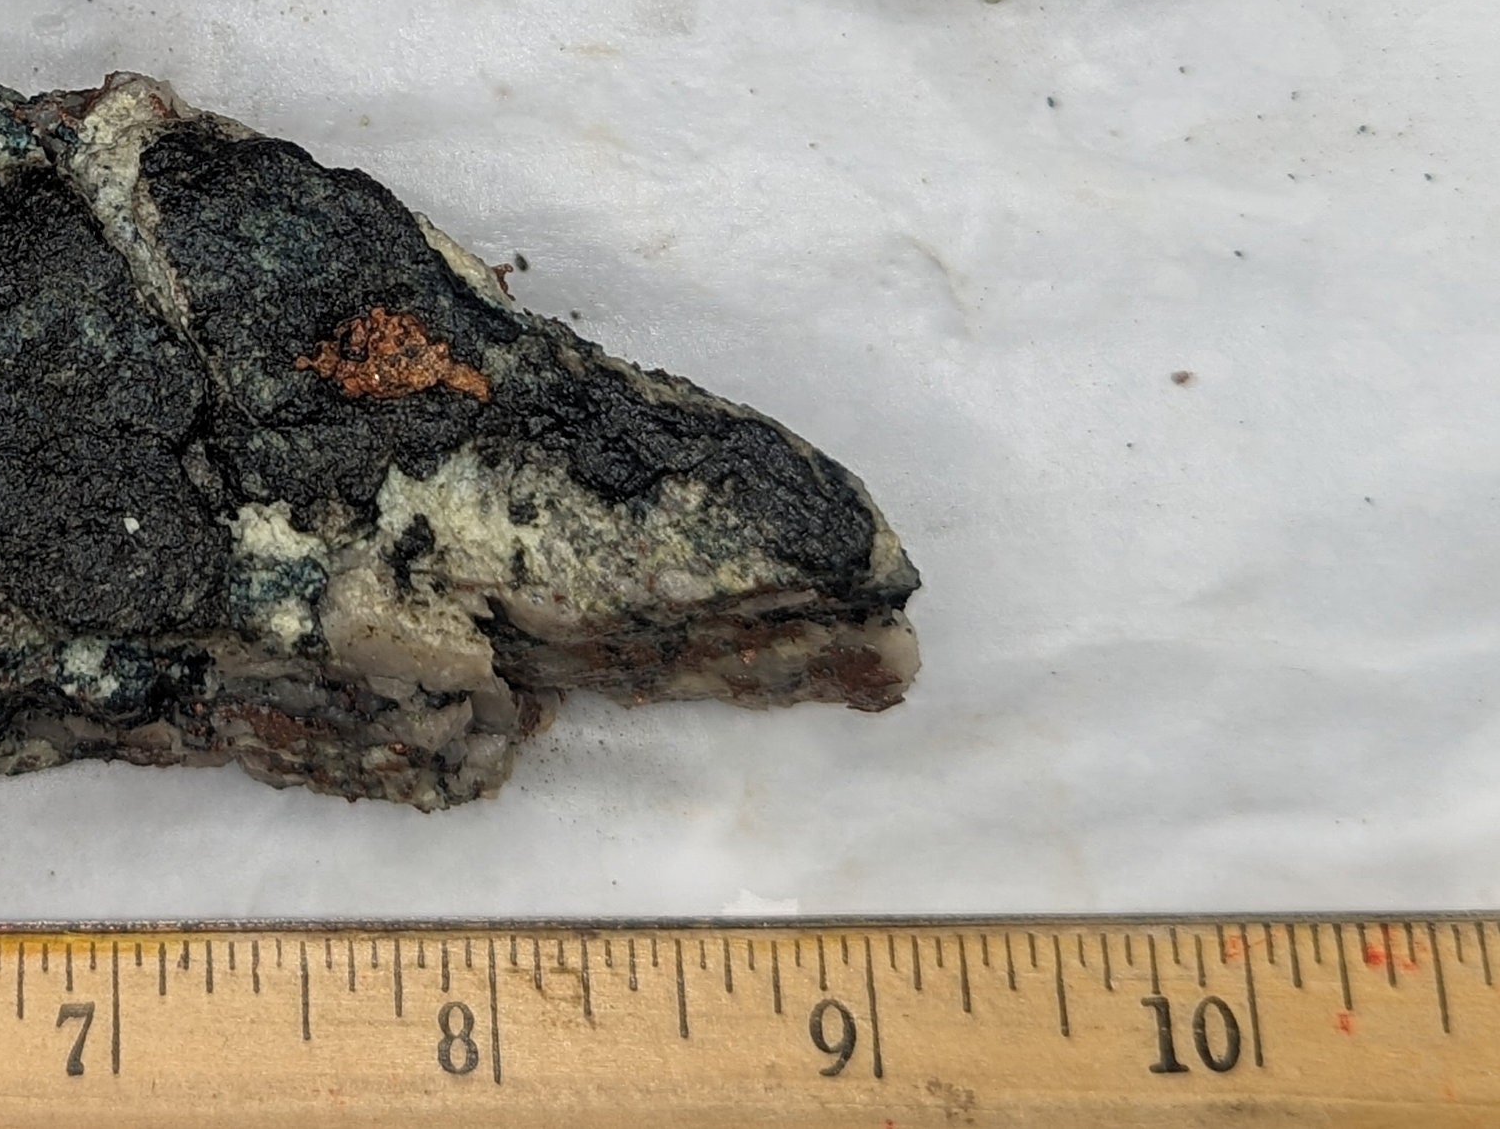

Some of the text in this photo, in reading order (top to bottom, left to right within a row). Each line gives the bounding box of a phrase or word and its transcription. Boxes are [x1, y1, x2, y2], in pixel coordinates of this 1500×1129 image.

[54, 1002, 96, 1077] 7
[436, 1000, 480, 1076] 8
[808, 998, 858, 1078] 9
[1140, 995, 1243, 1075] 10
